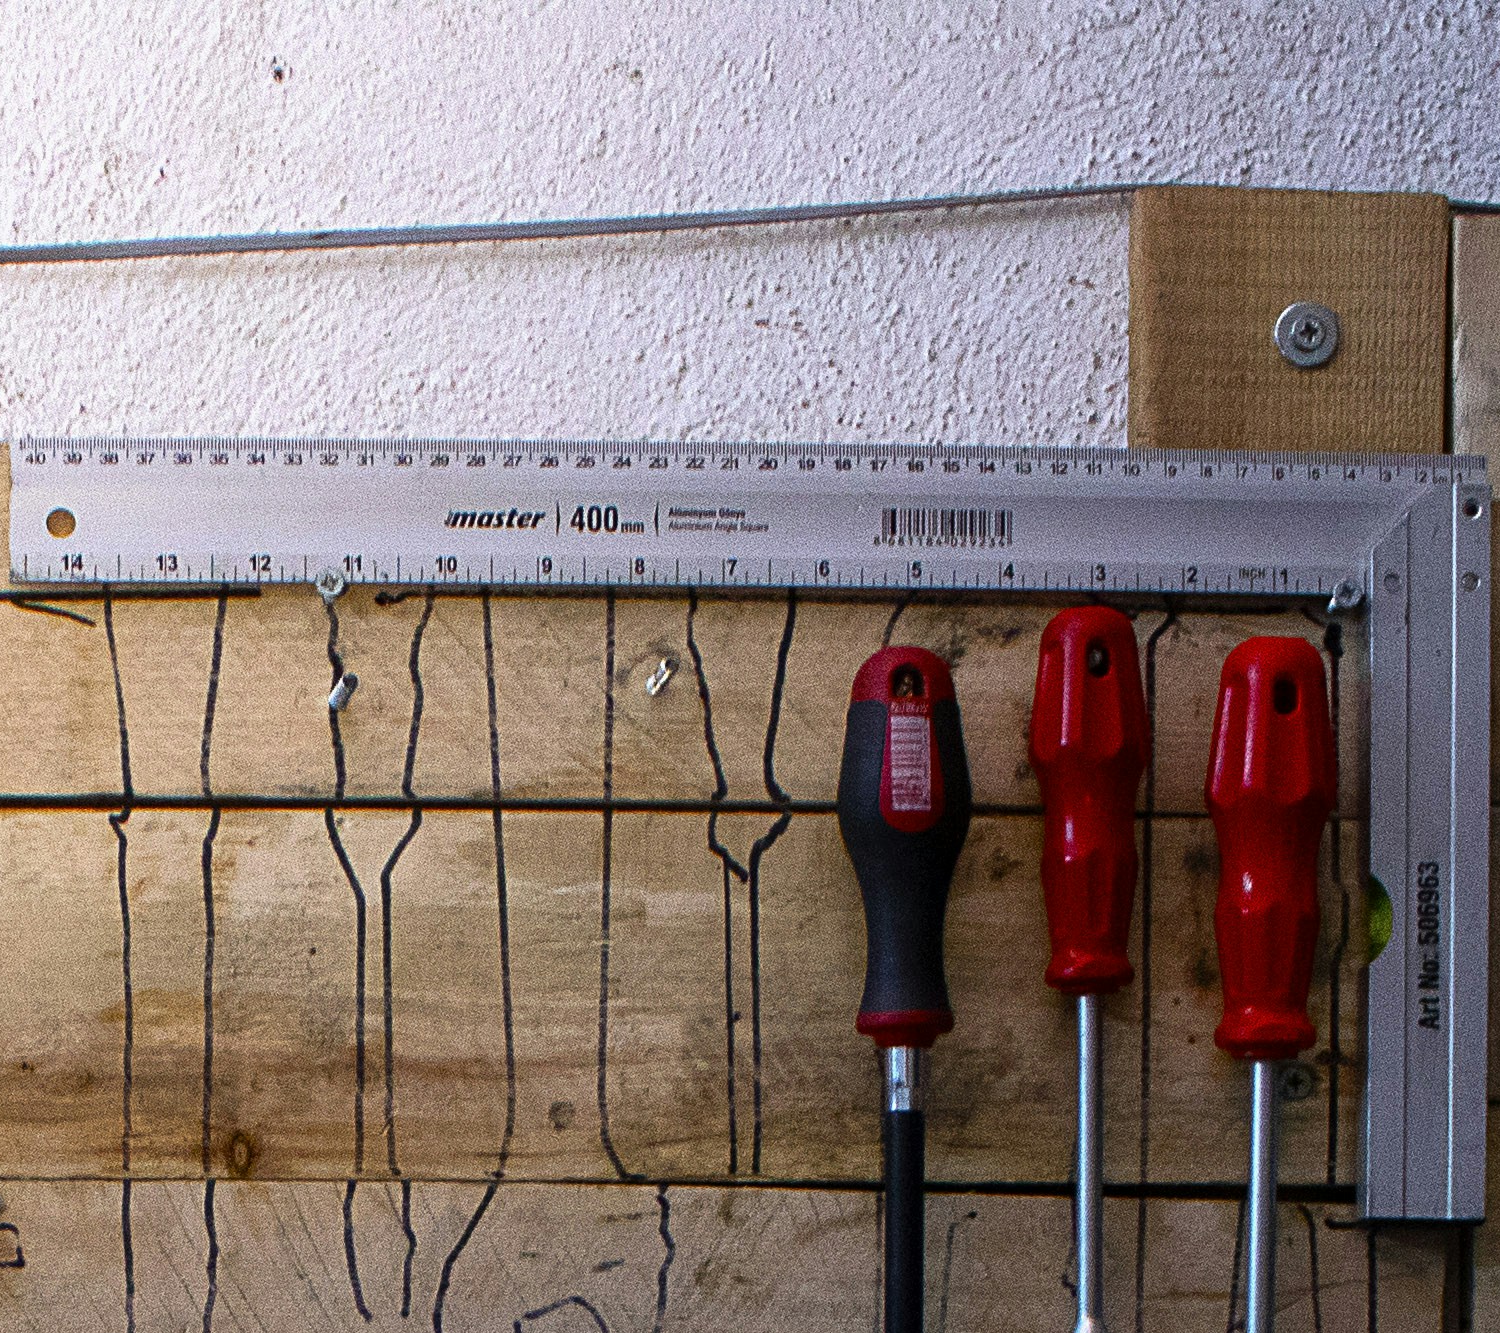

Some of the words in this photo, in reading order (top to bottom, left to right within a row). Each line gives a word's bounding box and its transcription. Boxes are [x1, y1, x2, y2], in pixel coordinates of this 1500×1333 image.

[61, 555, 83, 571] 14
[156, 555, 178, 571] 13
[249, 555, 270, 571] 12
[343, 555, 362, 571] 11
[435, 557, 457, 573] 10
[541, 557, 552, 573] 9
[634, 558, 645, 575] 8
[727, 559, 737, 576] 7
[818, 561, 830, 578] 6
[911, 562, 922, 578] 5
[1003, 563, 1014, 579] 4
[1095, 566, 1106, 582] 3
[1186, 567, 1198, 583] 2
[1418, 861, 1439, 946] 506963
[1418, 997, 1439, 1030] Art
